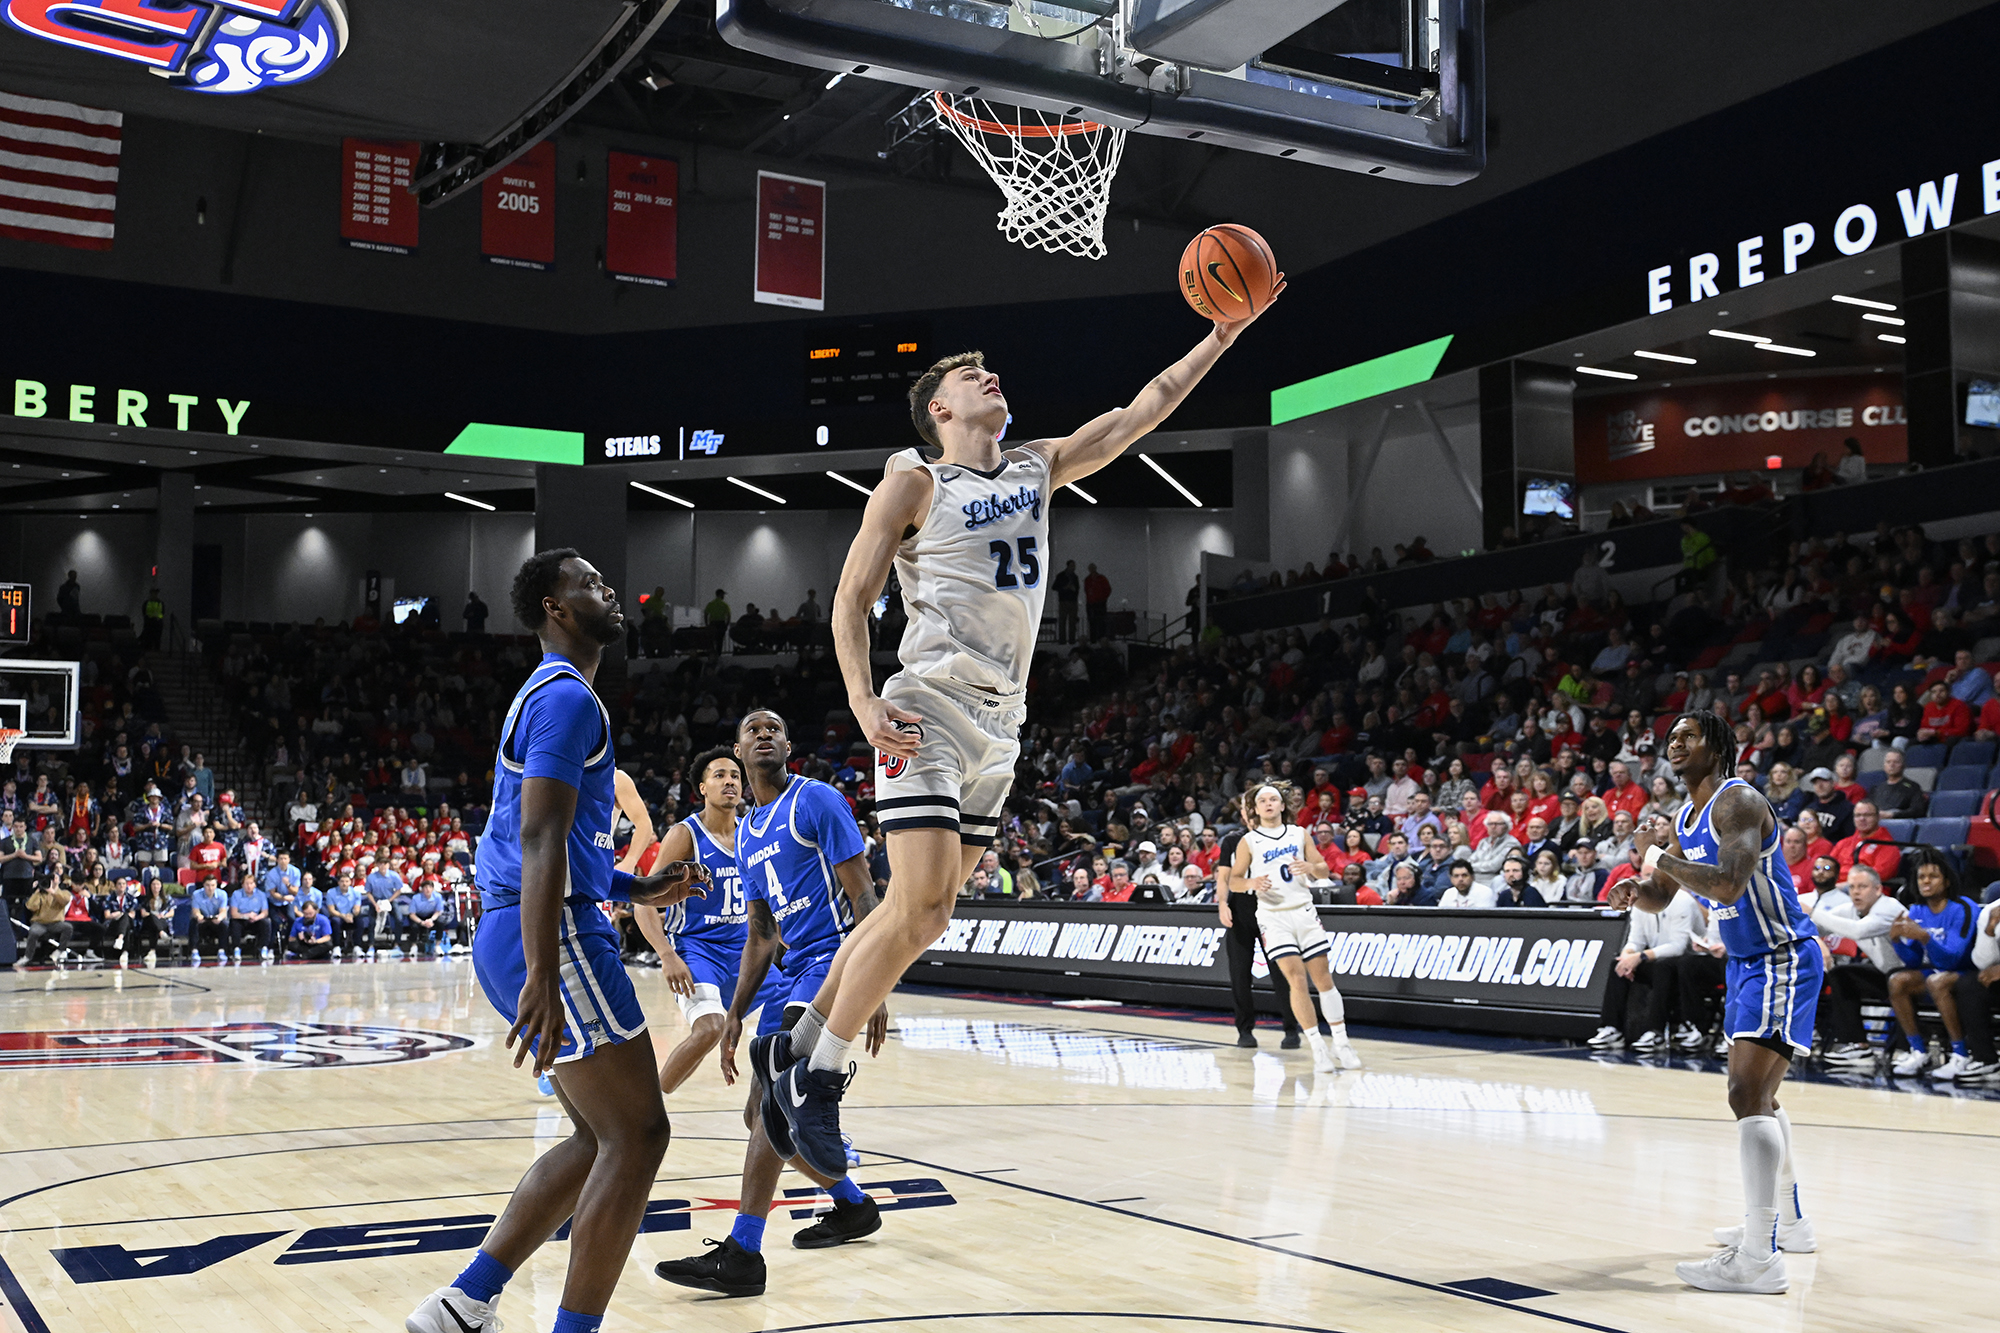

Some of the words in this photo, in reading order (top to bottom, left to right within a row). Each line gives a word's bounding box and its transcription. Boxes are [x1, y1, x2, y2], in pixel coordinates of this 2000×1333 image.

[497, 191, 540, 214] 2005
[1185, 269, 1214, 316] ELITE
[809, 348, 841, 359] LIBERTY
[897, 342, 918, 353] MTSU
[14, 379, 251, 436] BERTY
[1683, 408, 1854, 437] CONCOURSE
[604, 435, 661, 457] STEALS
[961, 484, 1041, 531] Liberty
[989, 536, 1041, 591] 25
[1597, 539, 1617, 568] 2
[747, 841, 781, 869] MIDDLE
[1262, 843, 1299, 864] Liberty
[764, 859, 788, 907] 4
[1279, 863, 1293, 883] 0
[720, 877, 746, 916] 15
[970, 920, 1006, 954] THE
[997, 920, 1060, 958] MOTOR
[1053, 922, 1118, 961] WORLD
[1111, 924, 1227, 967] DIFFERENCE
